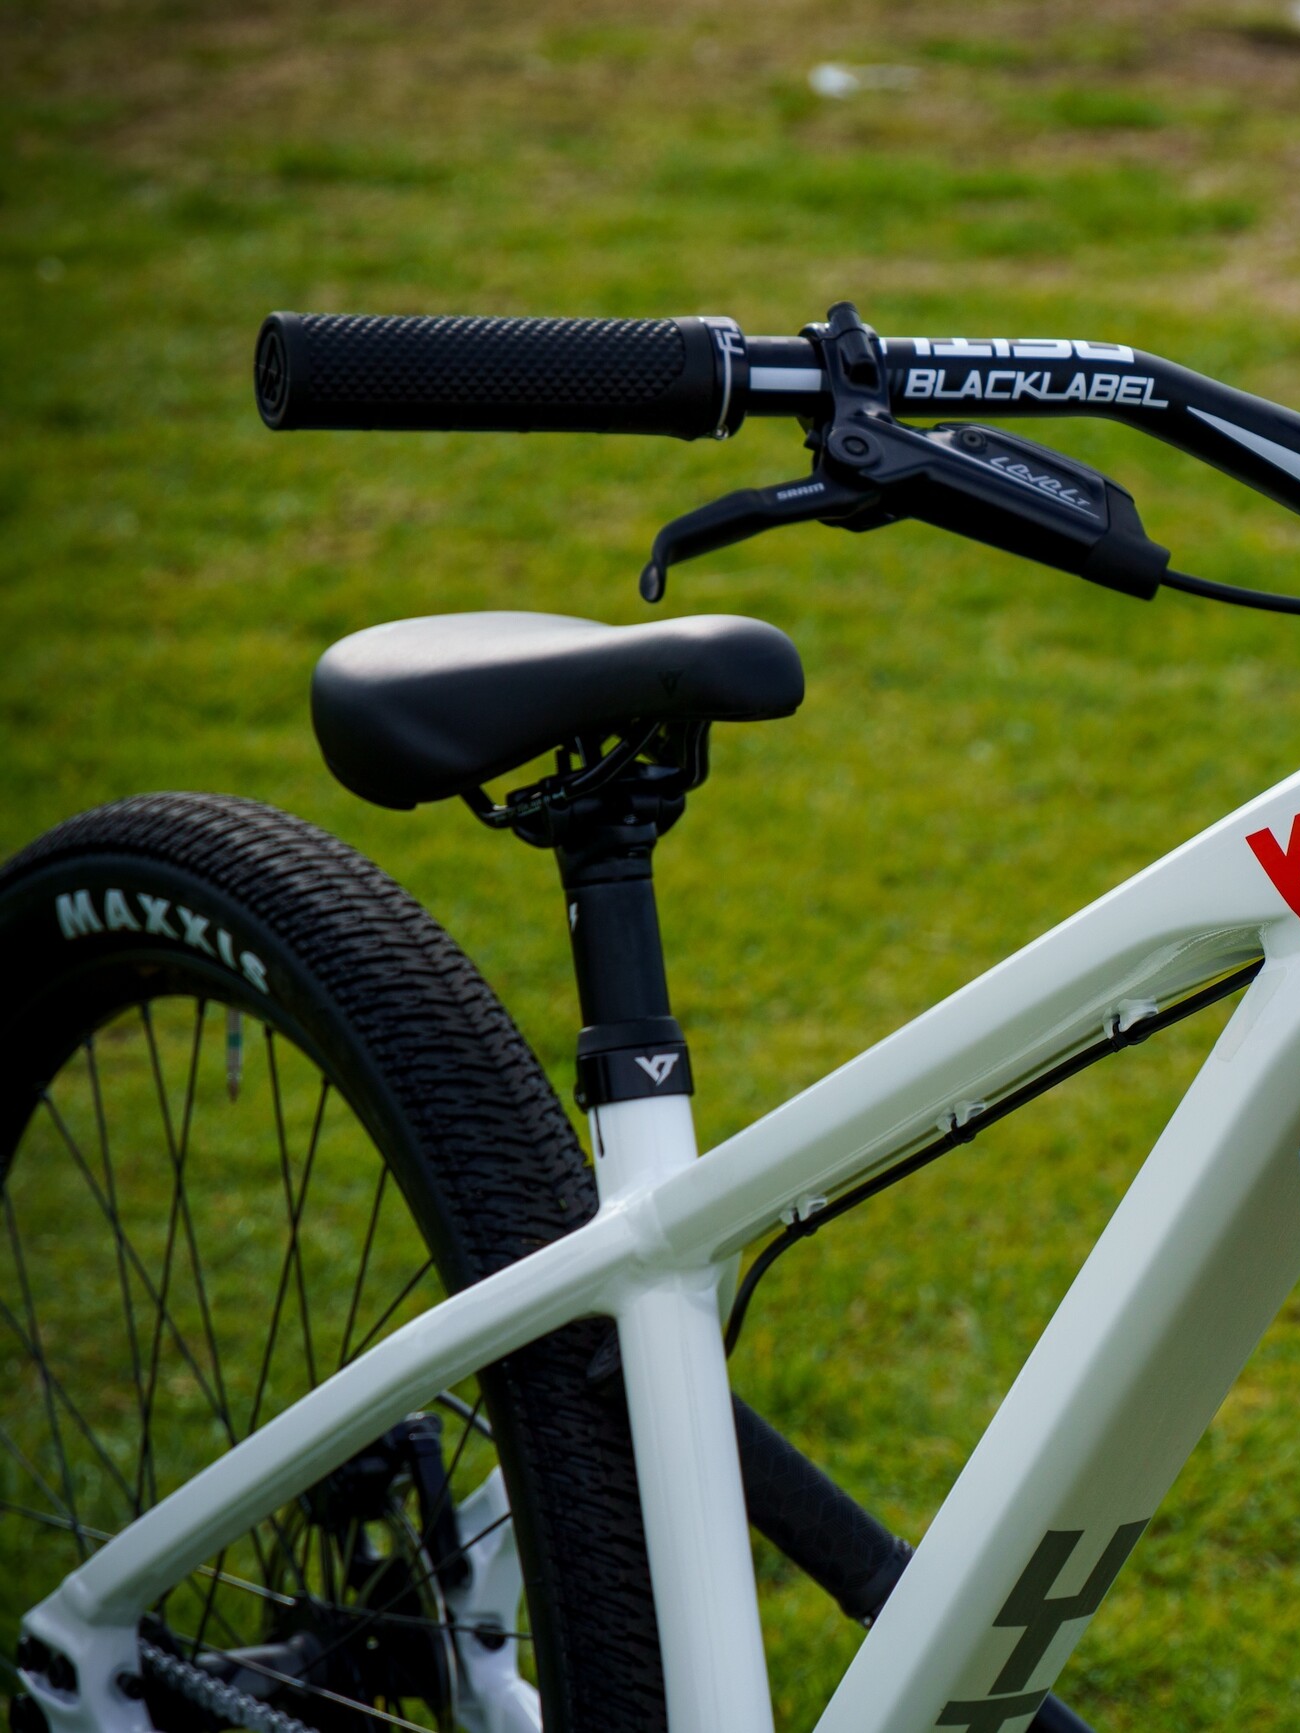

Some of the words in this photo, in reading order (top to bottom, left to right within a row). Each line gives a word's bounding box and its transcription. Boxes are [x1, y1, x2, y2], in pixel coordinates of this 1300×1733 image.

[904, 368, 1169, 408] BLACKLABEL
[776, 482, 825, 500] SRAM
[55, 888, 269, 994] MAXXIS
